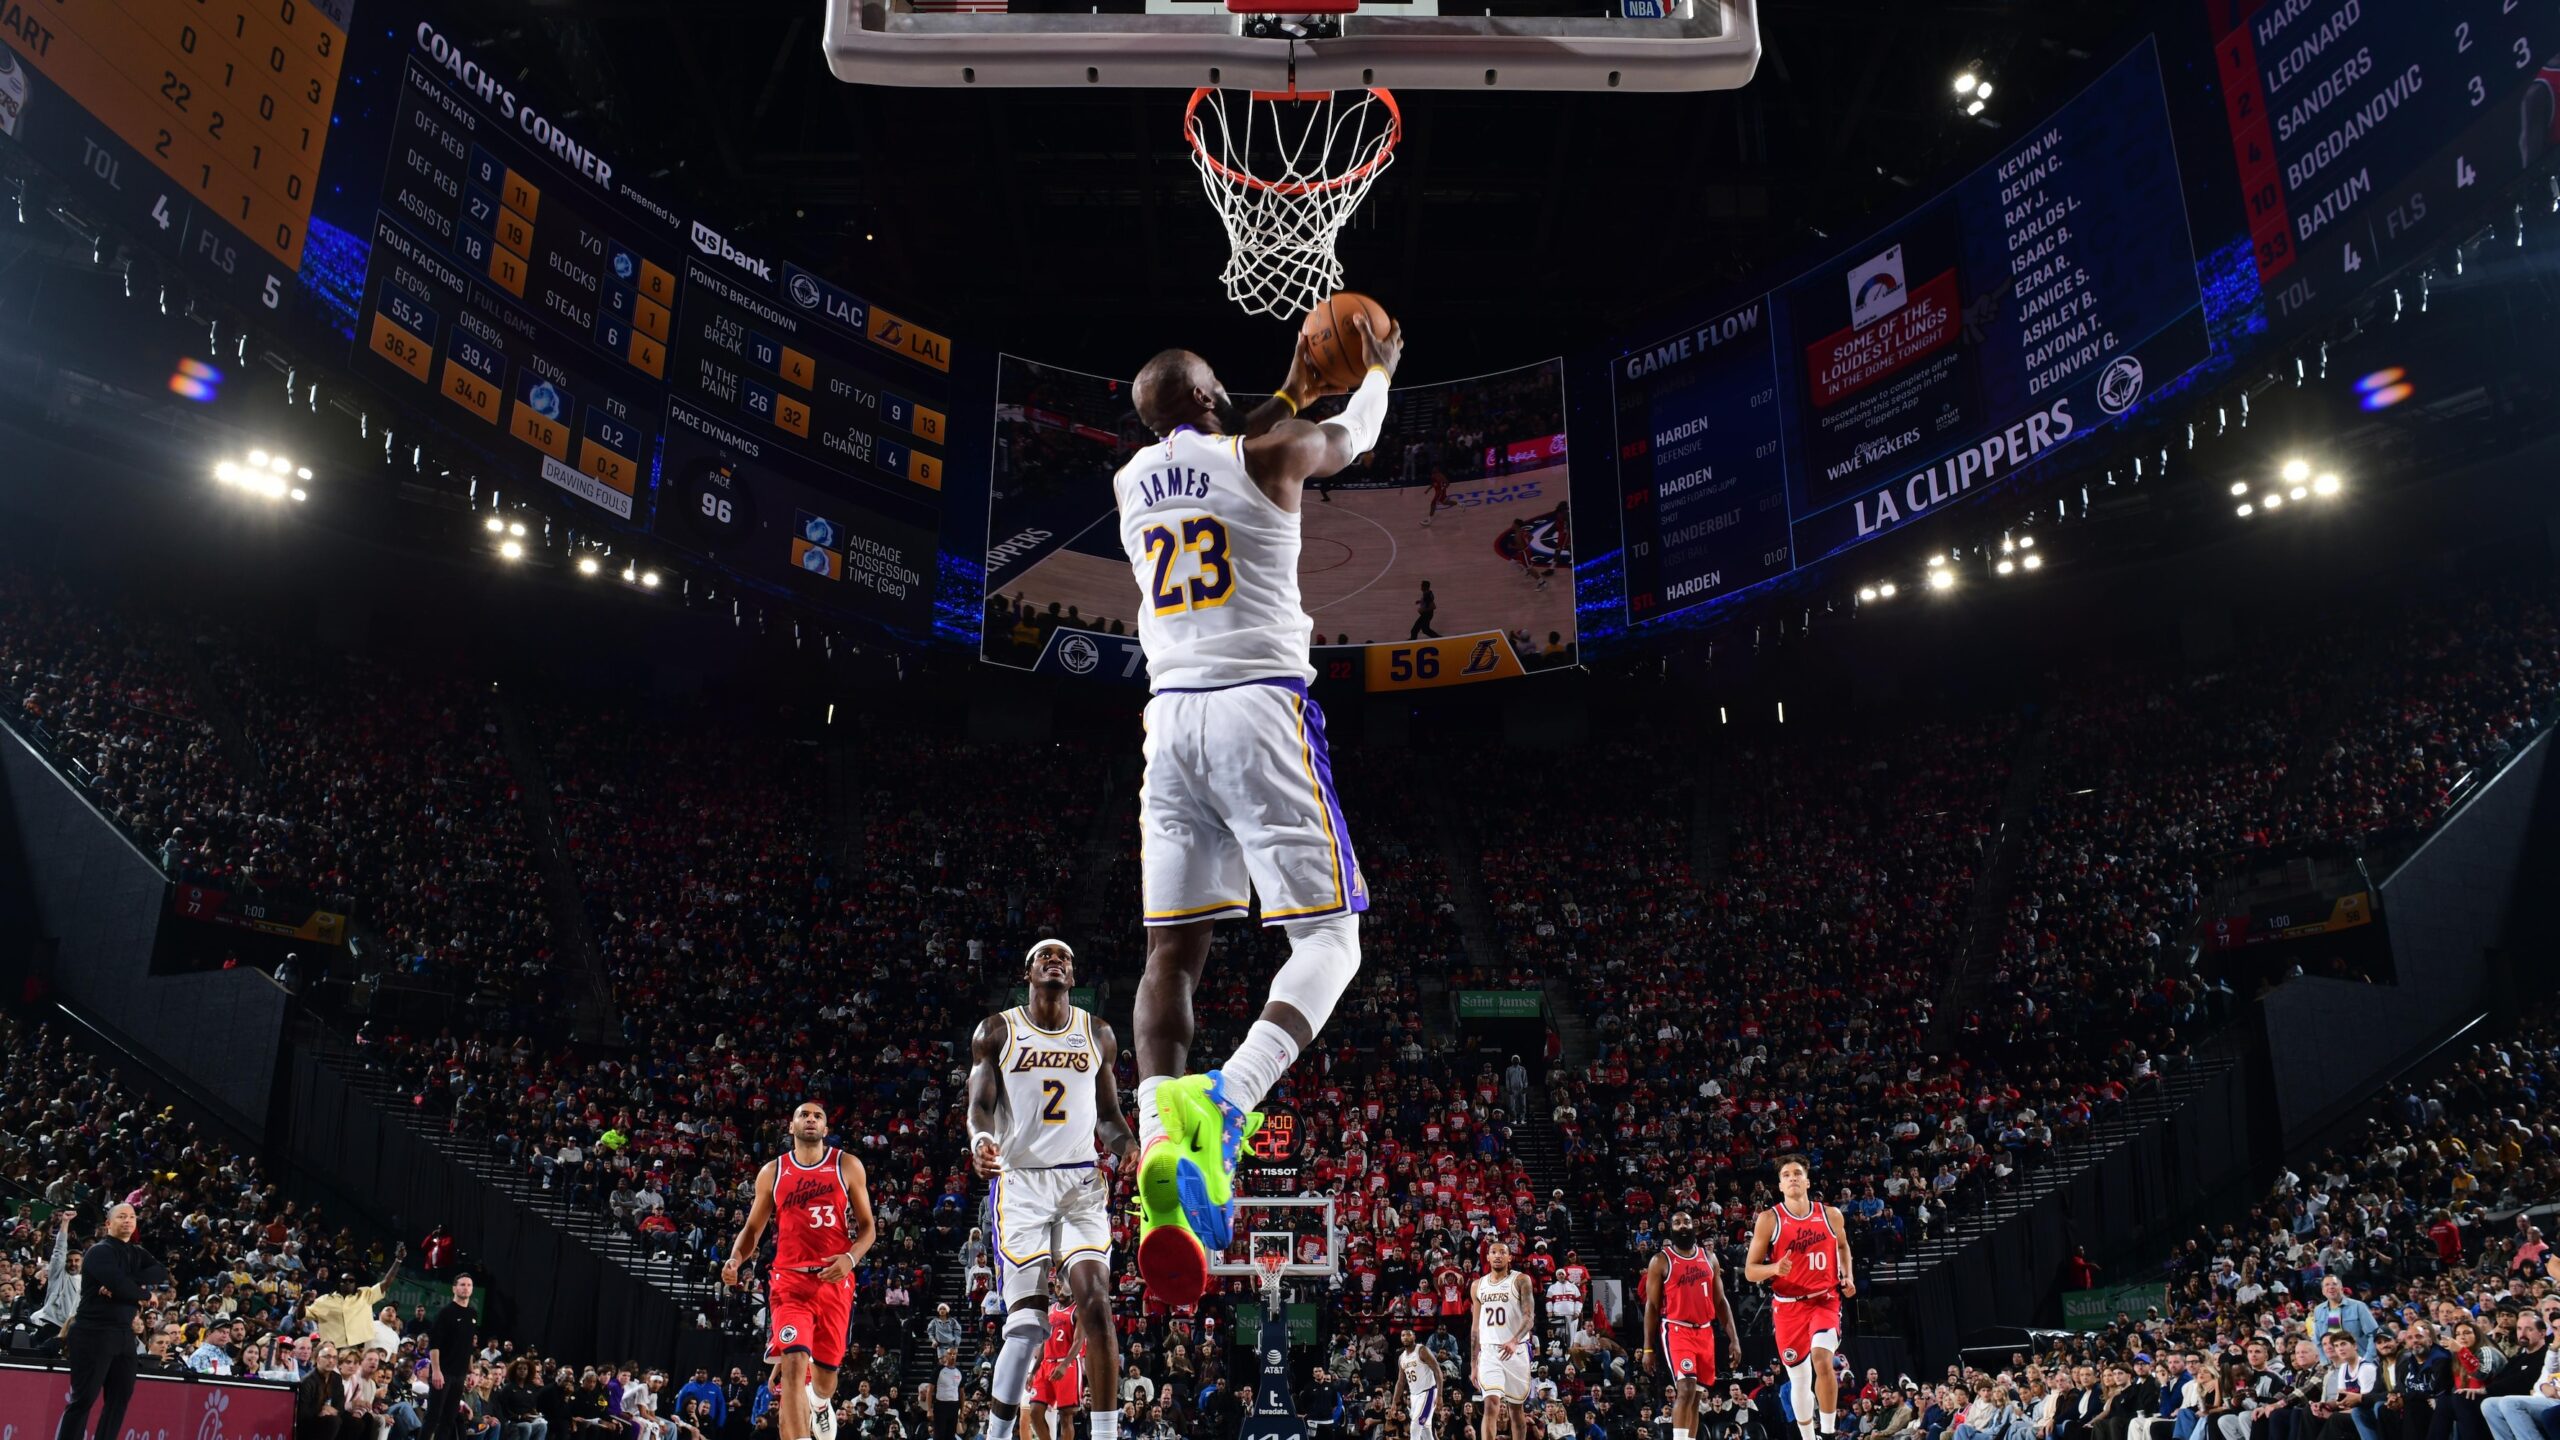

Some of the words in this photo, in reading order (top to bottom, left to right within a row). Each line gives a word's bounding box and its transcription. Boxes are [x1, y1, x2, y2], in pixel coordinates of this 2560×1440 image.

[1629, 1, 1655, 16] NBA
[0, 5, 54, 57] ART
[2267, 0, 2361, 95] LEONARD
[161, 71, 191, 112] 22
[409, 67, 442, 104] TEAM
[442, 95, 476, 132] STATS
[2277, 46, 2373, 142] SANDERS
[417, 21, 516, 120] COACH'S
[519, 106, 613, 191] CORNER
[621, 184, 668, 223] presented
[669, 212, 681, 230] by
[2287, 63, 2424, 191] BOGDANOVIC
[415, 110, 440, 138] OFF
[441, 131, 465, 160] REB
[481, 162, 492, 182] 9
[1997, 140, 2042, 184] KEVIN
[2043, 127, 2062, 150] W.
[83, 136, 121, 190] TOL
[152, 194, 169, 230] 4
[407, 148, 433, 177] DEF
[433, 169, 458, 198] REB
[470, 197, 490, 221] 27
[2001, 163, 2046, 207] DEVIN
[2048, 154, 2063, 173] C.
[2386, 192, 2428, 240] FLS
[2456, 155, 2477, 189] 4
[398, 188, 451, 237] ASSISTS
[465, 236, 482, 260] 18
[2004, 196, 2032, 229] RAY
[2034, 190, 2049, 208] J.
[2008, 202, 2066, 252] CARLOS
[2066, 195, 2081, 212] L.
[2297, 167, 2371, 242] BATUM
[379, 223, 411, 257] FOUR
[411, 248, 464, 294] FACTORS
[579, 230, 602, 256] T/O
[2011, 234, 2055, 276] ISAAC
[2057, 226, 2073, 245] B.
[200, 229, 236, 274] FLS
[262, 274, 281, 309] 5
[394, 266, 431, 302] EFG%
[549, 251, 597, 293] BLOCKS
[2014, 263, 2055, 299] EZRA
[2055, 254, 2071, 273] R.
[2276, 276, 2316, 317] TOL
[2343, 242, 2362, 274] 4
[391, 297, 424, 332] 55.2
[545, 289, 591, 329] STEALS
[690, 265, 728, 299] POINTS
[729, 289, 798, 333] BREAKDOWN
[826, 294, 863, 329] LAC
[2019, 275, 2074, 323] JANICE
[2075, 268, 2091, 287] S.
[460, 310, 503, 350] OREB%
[715, 314, 745, 340] FAST
[1833, 329, 1875, 363] SOME
[1878, 316, 1899, 338] OF
[1902, 297, 1932, 326] THE
[2022, 297, 2079, 348] ASHLEY
[2081, 290, 2098, 310] B.
[384, 333, 417, 367] 36.2
[461, 344, 492, 375] 39.4
[704, 324, 743, 357] BREAK
[756, 344, 773, 364] 10
[911, 333, 945, 364] LAL
[1626, 336, 1692, 380] GAME
[1697, 304, 1759, 353] FLOW
[1821, 338, 1891, 385] LOUDEST
[1895, 307, 1947, 348] LUNGS
[1828, 381, 1840, 396] IN
[1842, 370, 1863, 389] THE
[1865, 353, 1895, 378] DOME
[1898, 327, 1944, 361] TONIGHT
[2025, 322, 2088, 372] RAYONA
[2087, 313, 2102, 332] T.
[532, 354, 567, 388] TOV%
[701, 358, 714, 376] IN
[716, 365, 739, 387] THE
[2029, 338, 2101, 396] DEUNVRY
[2103, 331, 2120, 351] G.
[455, 378, 487, 409] 34.0
[606, 397, 627, 420] FTR
[701, 376, 738, 405] PAINT
[749, 391, 769, 413] 26
[783, 408, 802, 428] 32
[830, 377, 852, 398] OFF
[854, 388, 876, 409] T/O
[921, 415, 936, 434] 13
[1821, 404, 1859, 428] Discover
[1860, 394, 1878, 409] how
[1879, 388, 1889, 400] to
[1890, 368, 1930, 396] complete
[1931, 360, 1942, 376] all
[1943, 352, 1959, 367] the
[1834, 408, 1872, 433] missions
[1873, 401, 1890, 416] this
[1891, 383, 1922, 404] season
[1923, 377, 1932, 389] in
[1933, 369, 1949, 385] the
[671, 405, 700, 431] PACE
[702, 414, 760, 458] DYNAMICS
[1656, 416, 1708, 448] HARDEN
[1864, 406, 1900, 430] Clippers
[1902, 395, 1920, 414] App
[601, 424, 624, 449] 0.2
[823, 431, 872, 464] CHANCE
[848, 426, 872, 448] 2ND
[1657, 439, 1703, 466] DEFENSIVE
[1826, 454, 1863, 481] WAVE
[1865, 426, 1921, 465] MAKERS
[709, 471, 732, 490] PACE
[1140, 467, 1210, 507] JAMES
[1659, 465, 1712, 498] HARDEN
[1853, 489, 1901, 537] LA
[1905, 398, 2074, 512] CLIPPERS
[546, 463, 594, 498] DRAWING
[595, 488, 628, 514] FOULS
[701, 491, 732, 524] 96
[850, 534, 902, 565] AVERAGE
[1632, 541, 1649, 559] TO
[1662, 508, 1742, 548] VANDERBILT
[849, 566, 875, 590] TIME
[877, 576, 906, 601] (Sec)
[850, 549, 920, 587] POSSESSION
[1142, 514, 1236, 618] 23
[1666, 570, 1721, 601] HARDEN
[1390, 647, 1440, 682] 56
[244, 904, 265, 919] 1:00
[2269, 914, 2290, 929] 1:00
[1461, 995, 1493, 1008] Saint
[1498, 995, 1537, 1008] James
[1010, 1047, 1089, 1073] LAKERS
[1042, 1079, 1068, 1126] 2
[1255, 1130, 1290, 1157] 22
[796, 1177, 817, 1193] Los
[1261, 1168, 1298, 1176] TISSOT
[782, 1182, 834, 1210] Angeles
[808, 1205, 836, 1229] 33
[1796, 1227, 1813, 1241] Los
[1786, 1232, 1827, 1254] Angeles
[1806, 1251, 1827, 1271] 10
[1481, 1292, 1509, 1305] LAKERS
[1701, 1281, 1708, 1297] 1
[1056, 1329, 1065, 1342] 2
[1485, 1307, 1506, 1327] 20
[1264, 1366, 1284, 1375] AT&T
